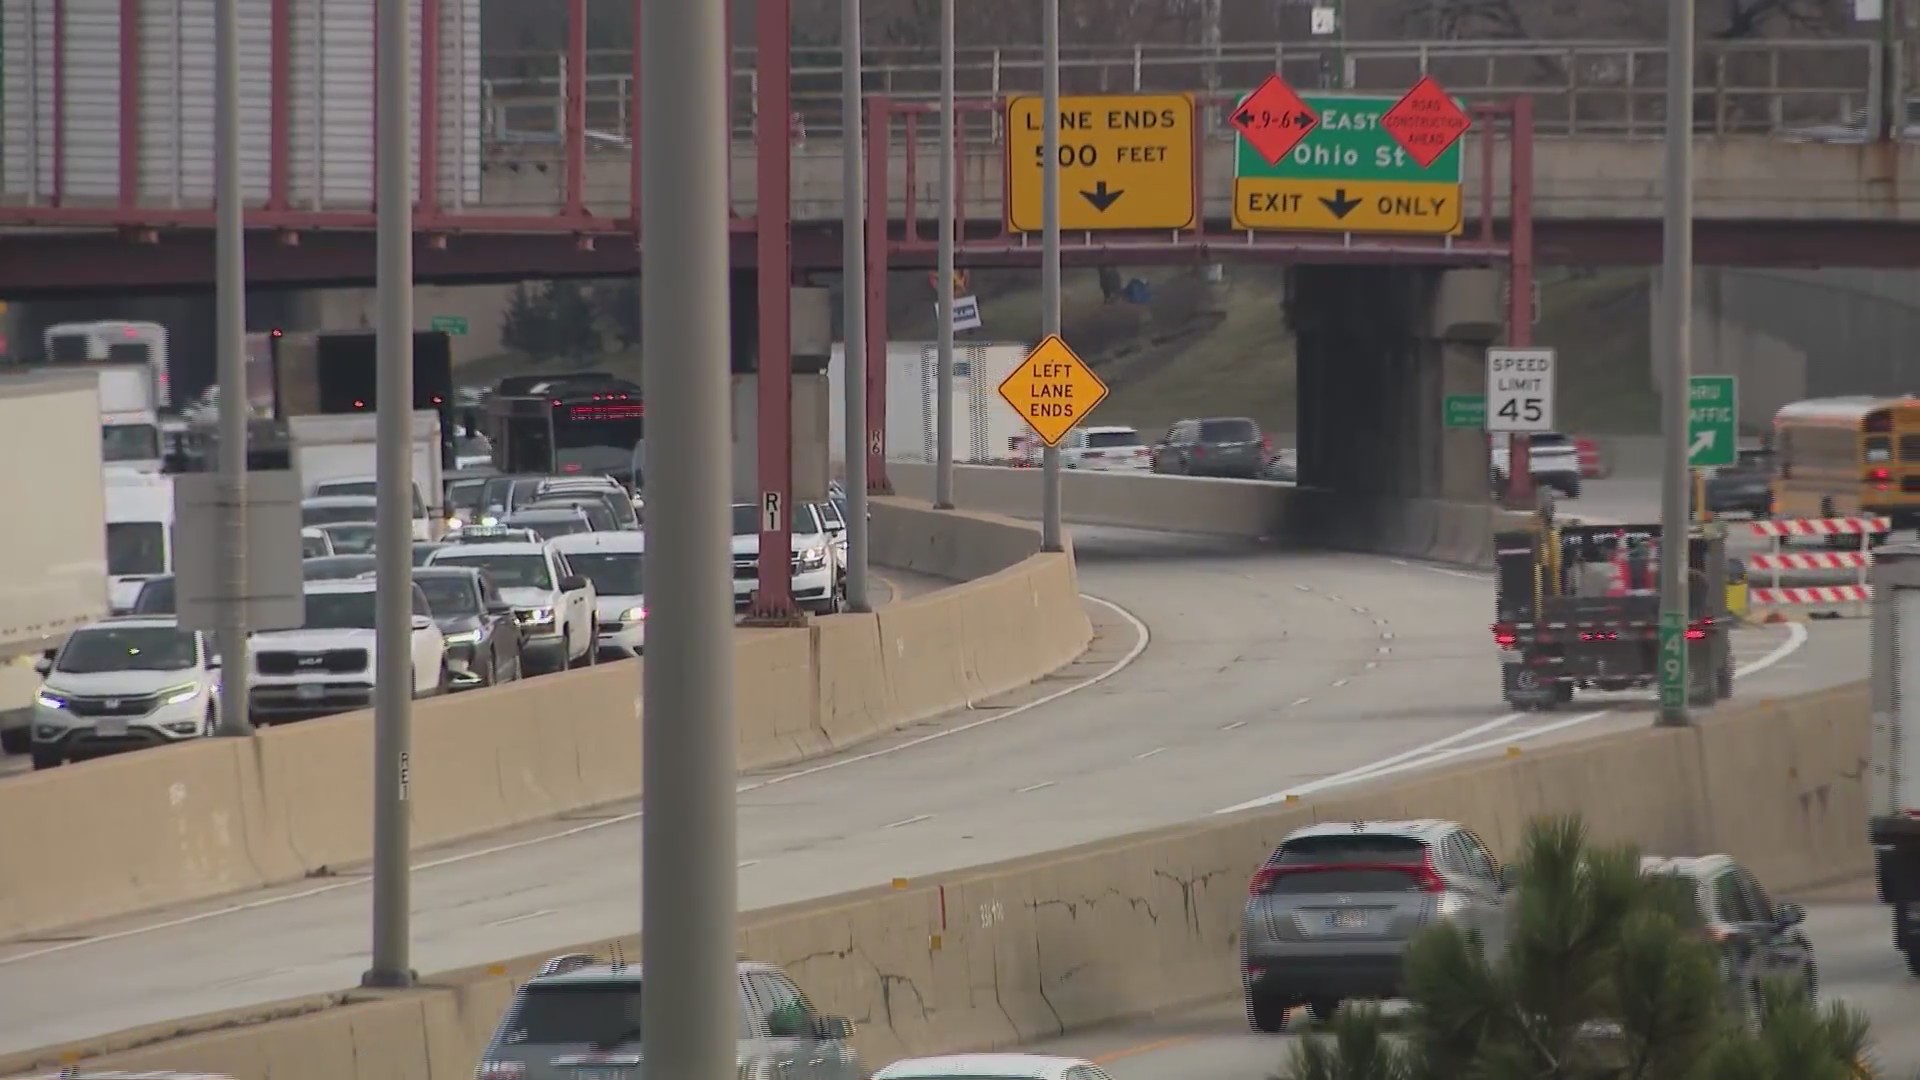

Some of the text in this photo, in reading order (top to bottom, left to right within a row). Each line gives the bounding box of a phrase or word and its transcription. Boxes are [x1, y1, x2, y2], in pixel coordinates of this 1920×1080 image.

[1411, 99, 1441, 111] ROAD
[1026, 109, 1175, 130] LNE ENDS
[1321, 109, 1380, 131] EAST
[1386, 112, 1463, 127] CONSTRUCTION
[1407, 133, 1445, 145] AHEAD
[1117, 146, 1168, 163] FEET
[1294, 144, 1405, 167] Ohio St
[1249, 193, 1446, 216] EXIT ONLY
[1033, 363, 1072, 378] LEFT
[1492, 358, 1549, 372] SPEED
[1031, 383, 1073, 398] LANE
[1498, 378, 1542, 391] LIMIT
[1030, 403, 1073, 417] ENDS
[1497, 398, 1543, 422] 45
[1688, 407, 1732, 422] AFFIC
